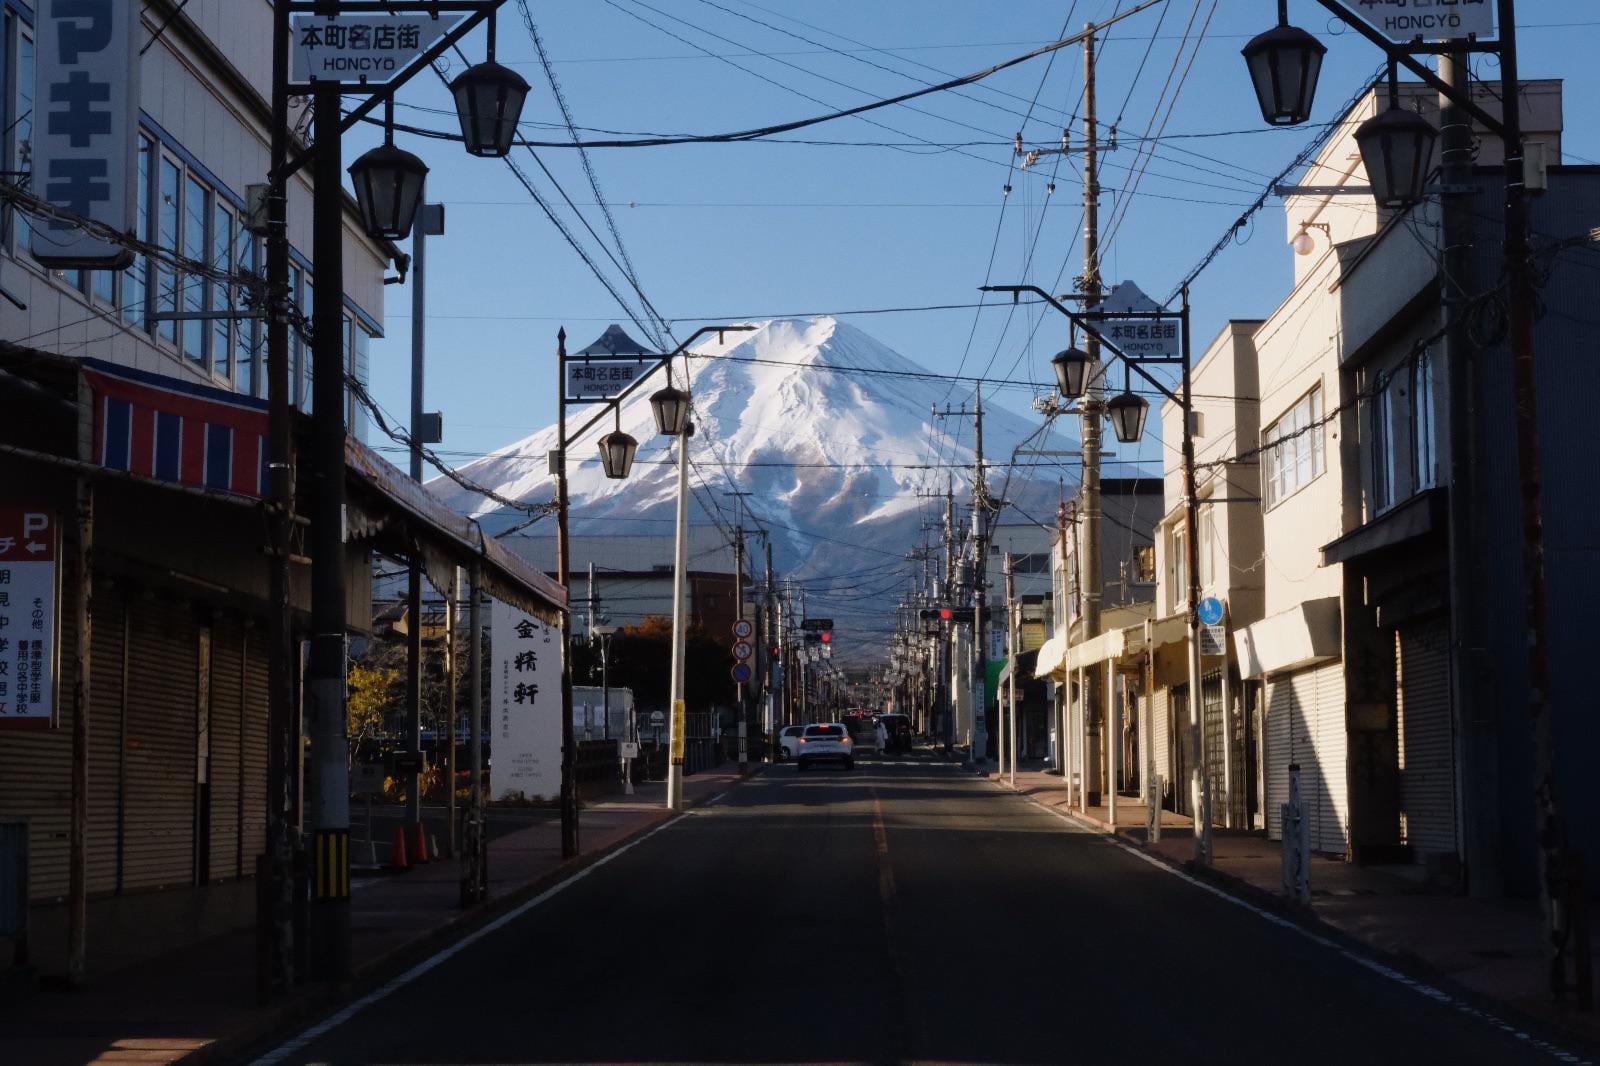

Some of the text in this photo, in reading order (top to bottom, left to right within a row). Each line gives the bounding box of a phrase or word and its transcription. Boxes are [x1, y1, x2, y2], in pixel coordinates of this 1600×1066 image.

[300, 24, 421, 50] 本町名店街
[1112, 325, 1176, 340] 本町名店街
[572, 367, 633, 381] 本町名店街
[23, 512, 49, 539] P
[737, 624, 748, 634] 40
[513, 618, 539, 705] 金精軒
